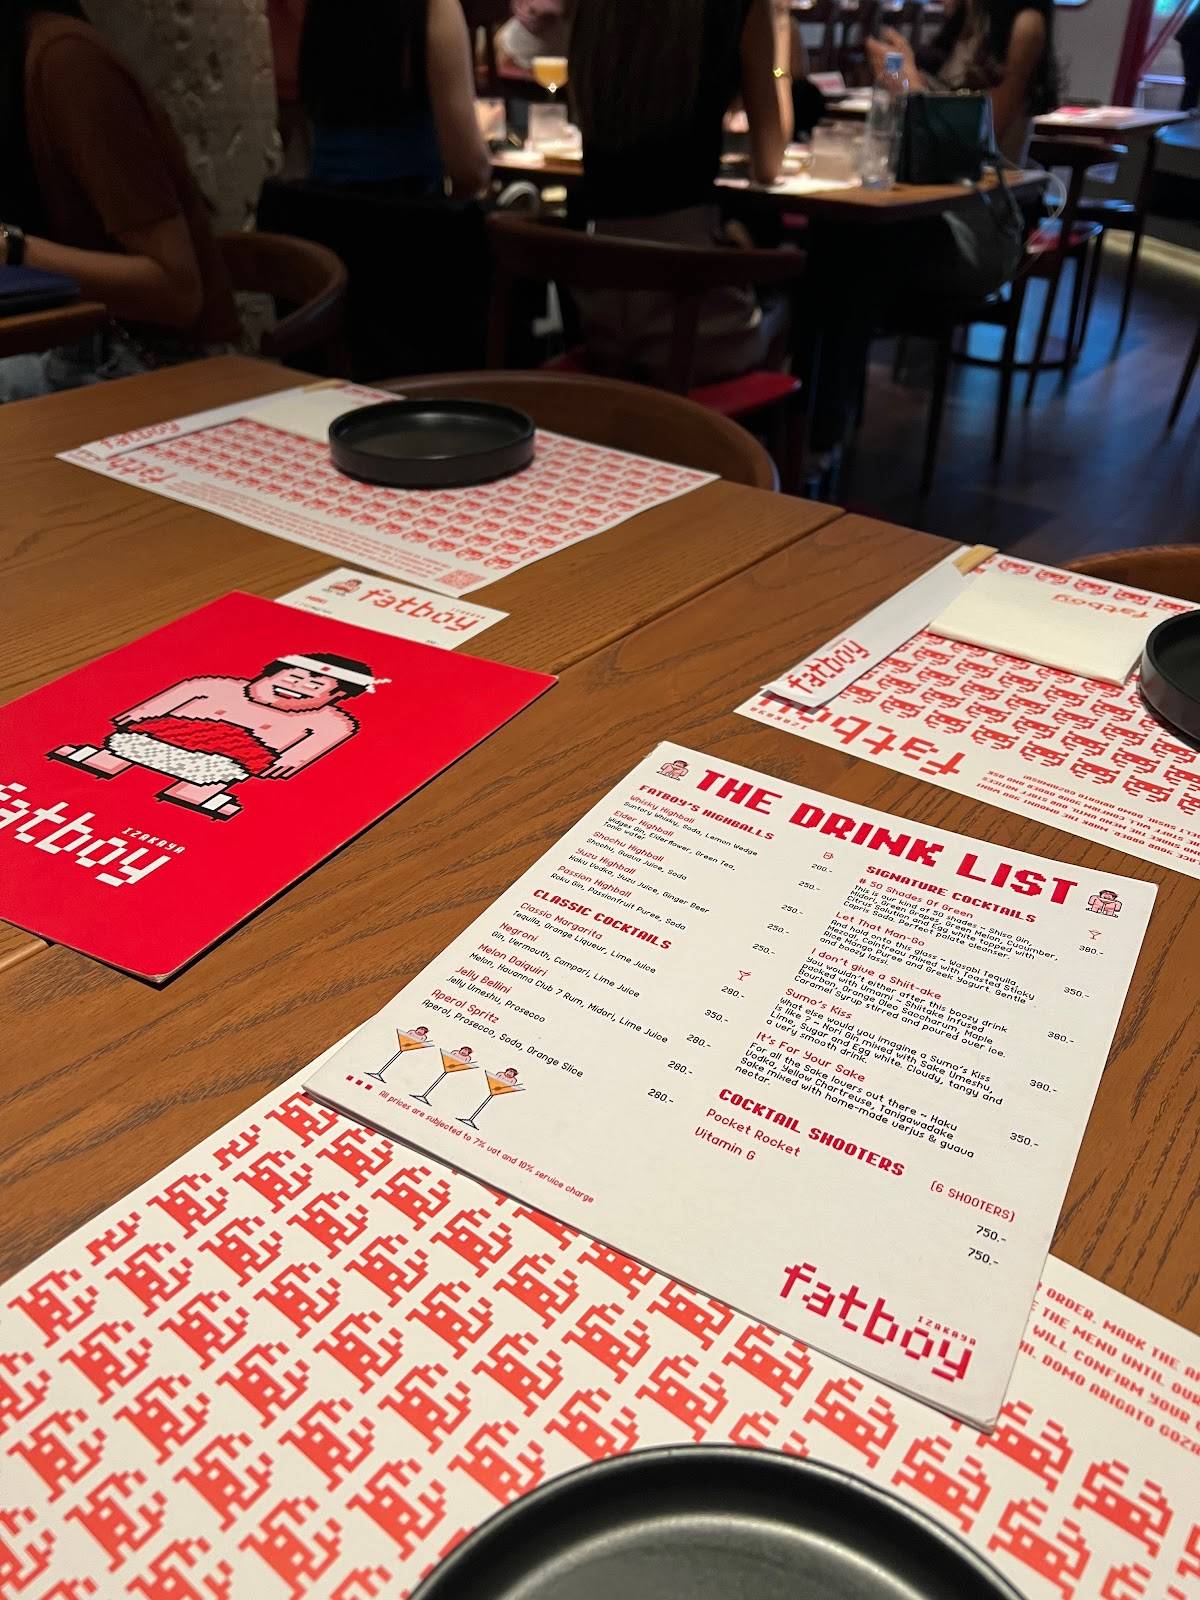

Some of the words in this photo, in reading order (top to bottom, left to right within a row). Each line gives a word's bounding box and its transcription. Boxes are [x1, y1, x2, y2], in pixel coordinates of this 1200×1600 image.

[357, 588, 479, 631] fatboy
[786, 639, 871, 694] fatboy
[613, 810, 637, 822] Elder
[638, 819, 674, 837] Highball
[623, 801, 653, 816] Suntory
[654, 812, 679, 827] Whisky,
[682, 824, 702, 836] Soda,
[705, 833, 731, 846] Lemon
[733, 843, 758, 856] Wedge
[630, 794, 659, 810] Whisky
[659, 806, 695, 824] Highball
[702, 809, 774, 840] HIGHBALLS
[121, 827, 186, 854] IZAKAYA
[593, 831, 626, 847] Shochu
[627, 844, 665, 862] Highball
[697, 770, 782, 815] THE
[788, 804, 944, 868] DRINK
[956, 853, 1078, 905] LIST
[557, 865, 592, 882] Passion
[593, 879, 632, 898] Highball
[575, 847, 598, 860] Yuzu
[599, 856, 636, 875] Highball
[866, 866, 948, 897] SIGNATURE
[951, 892, 1036, 923] COCKTAILS
[869, 881, 883, 890] 50
[885, 886, 922, 902] Shades
[926, 899, 939, 907] Of
[941, 904, 973, 919] Green
[499, 922, 539, 942] Negroni
[520, 902, 552, 919] Classic
[553, 915, 603, 940] Margarita
[533, 889, 592, 916] CLASSIC
[593, 912, 672, 949] COCKTAILS
[835, 911, 855, 923] Let
[858, 918, 881, 932] That
[884, 928, 925, 946] Man-Go
[477, 943, 507, 960] Melon
[508, 955, 548, 977] Daiquiri
[513, 910, 541, 927] Tequila,
[544, 922, 573, 939] Orange
[573, 935, 607, 955] Liqueur,
[610, 950, 632, 963] Lime
[633, 960, 656, 974] Juice
[455, 966, 480, 981] Jelly
[479, 975, 513, 994] Bellini
[491, 931, 505, 942] Gin,
[508, 937, 550, 961] Vermouth,
[553, 956, 591, 978] Campari,
[593, 973, 615, 987] Lime
[616, 984, 640, 998] Juice
[850, 964, 875, 976] give
[431, 989, 467, 1008] Aperol
[467, 1004, 499, 1024] Spritz
[446, 975, 466, 988] Jelly
[467, 983, 501, 1005] Umeshu,
[504, 1000, 545, 1023] Prosecco
[469, 952, 494, 969] Melon,
[534, 980, 553, 992] Club
[562, 992, 584, 1008] Rum,
[587, 1003, 616, 1022] Midori,
[619, 1017, 642, 1032] Lime
[643, 1028, 668, 1043] Juice
[830, 1005, 852, 1019] Kiss
[421, 999, 452, 1018] Aperol,
[453, 1012, 496, 1038] Prosecco,
[499, 1033, 523, 1051] Soda,
[526, 1046, 559, 1066] Orange
[561, 1062, 583, 1077] Slice
[735, 1066, 770, 1085] nectar.
[778, 1041, 800, 1054] For
[802, 1050, 832, 1067] Your
[835, 1064, 865, 1082] Sake
[740, 1057, 765, 1072] Sake
[766, 1068, 799, 1086] mixed
[801, 1083, 822, 1096] with
[824, 1092, 888, 1124] home-made
[891, 1120, 925, 1138] verjus
[940, 1140, 974, 1158] guava
[378, 1090, 390, 1099] All
[386, 1096, 411, 1110] prices
[411, 1108, 425, 1118] are
[425, 1115, 463, 1136] subjected
[463, 1132, 472, 1141] to
[472, 1137, 487, 1148] 7%
[486, 1146, 501, 1156] vat
[501, 1153, 518, 1164] and
[518, 1160, 534, 1172] 10%
[534, 1170, 564, 1188] service
[565, 1185, 594, 1203] charge
[694, 1126, 742, 1155] Vitamin
[705, 1108, 751, 1135] Pocket
[753, 1129, 800, 1157] Rocket
[718, 1088, 800, 1133] COCKTAIL
[808, 1127, 905, 1176] SHOOTERS
[930, 1180, 944, 1193] (6
[947, 1188, 1015, 1223] SHOOTERS)
[780, 1262, 973, 1382] fatboy
[917, 1316, 977, 1346] IZAKAYA
[1046, 1288, 1096, 1323] ORDER.
[1103, 1320, 1147, 1350] MARK
[1152, 1347, 1181, 1370] THE
[1043, 1307, 1070, 1329] THE
[1073, 1325, 1118, 1357] MENU
[1121, 1352, 1164, 1386] UNTIL
[1033, 1324, 1067, 1354] WILL
[1073, 1349, 1145, 1397] CONFIRM
[1148, 1393, 1191, 1424] YOUR
[1042, 1354, 1086, 1387] DOMO
[1089, 1383, 1155, 1428] ARIGATO
